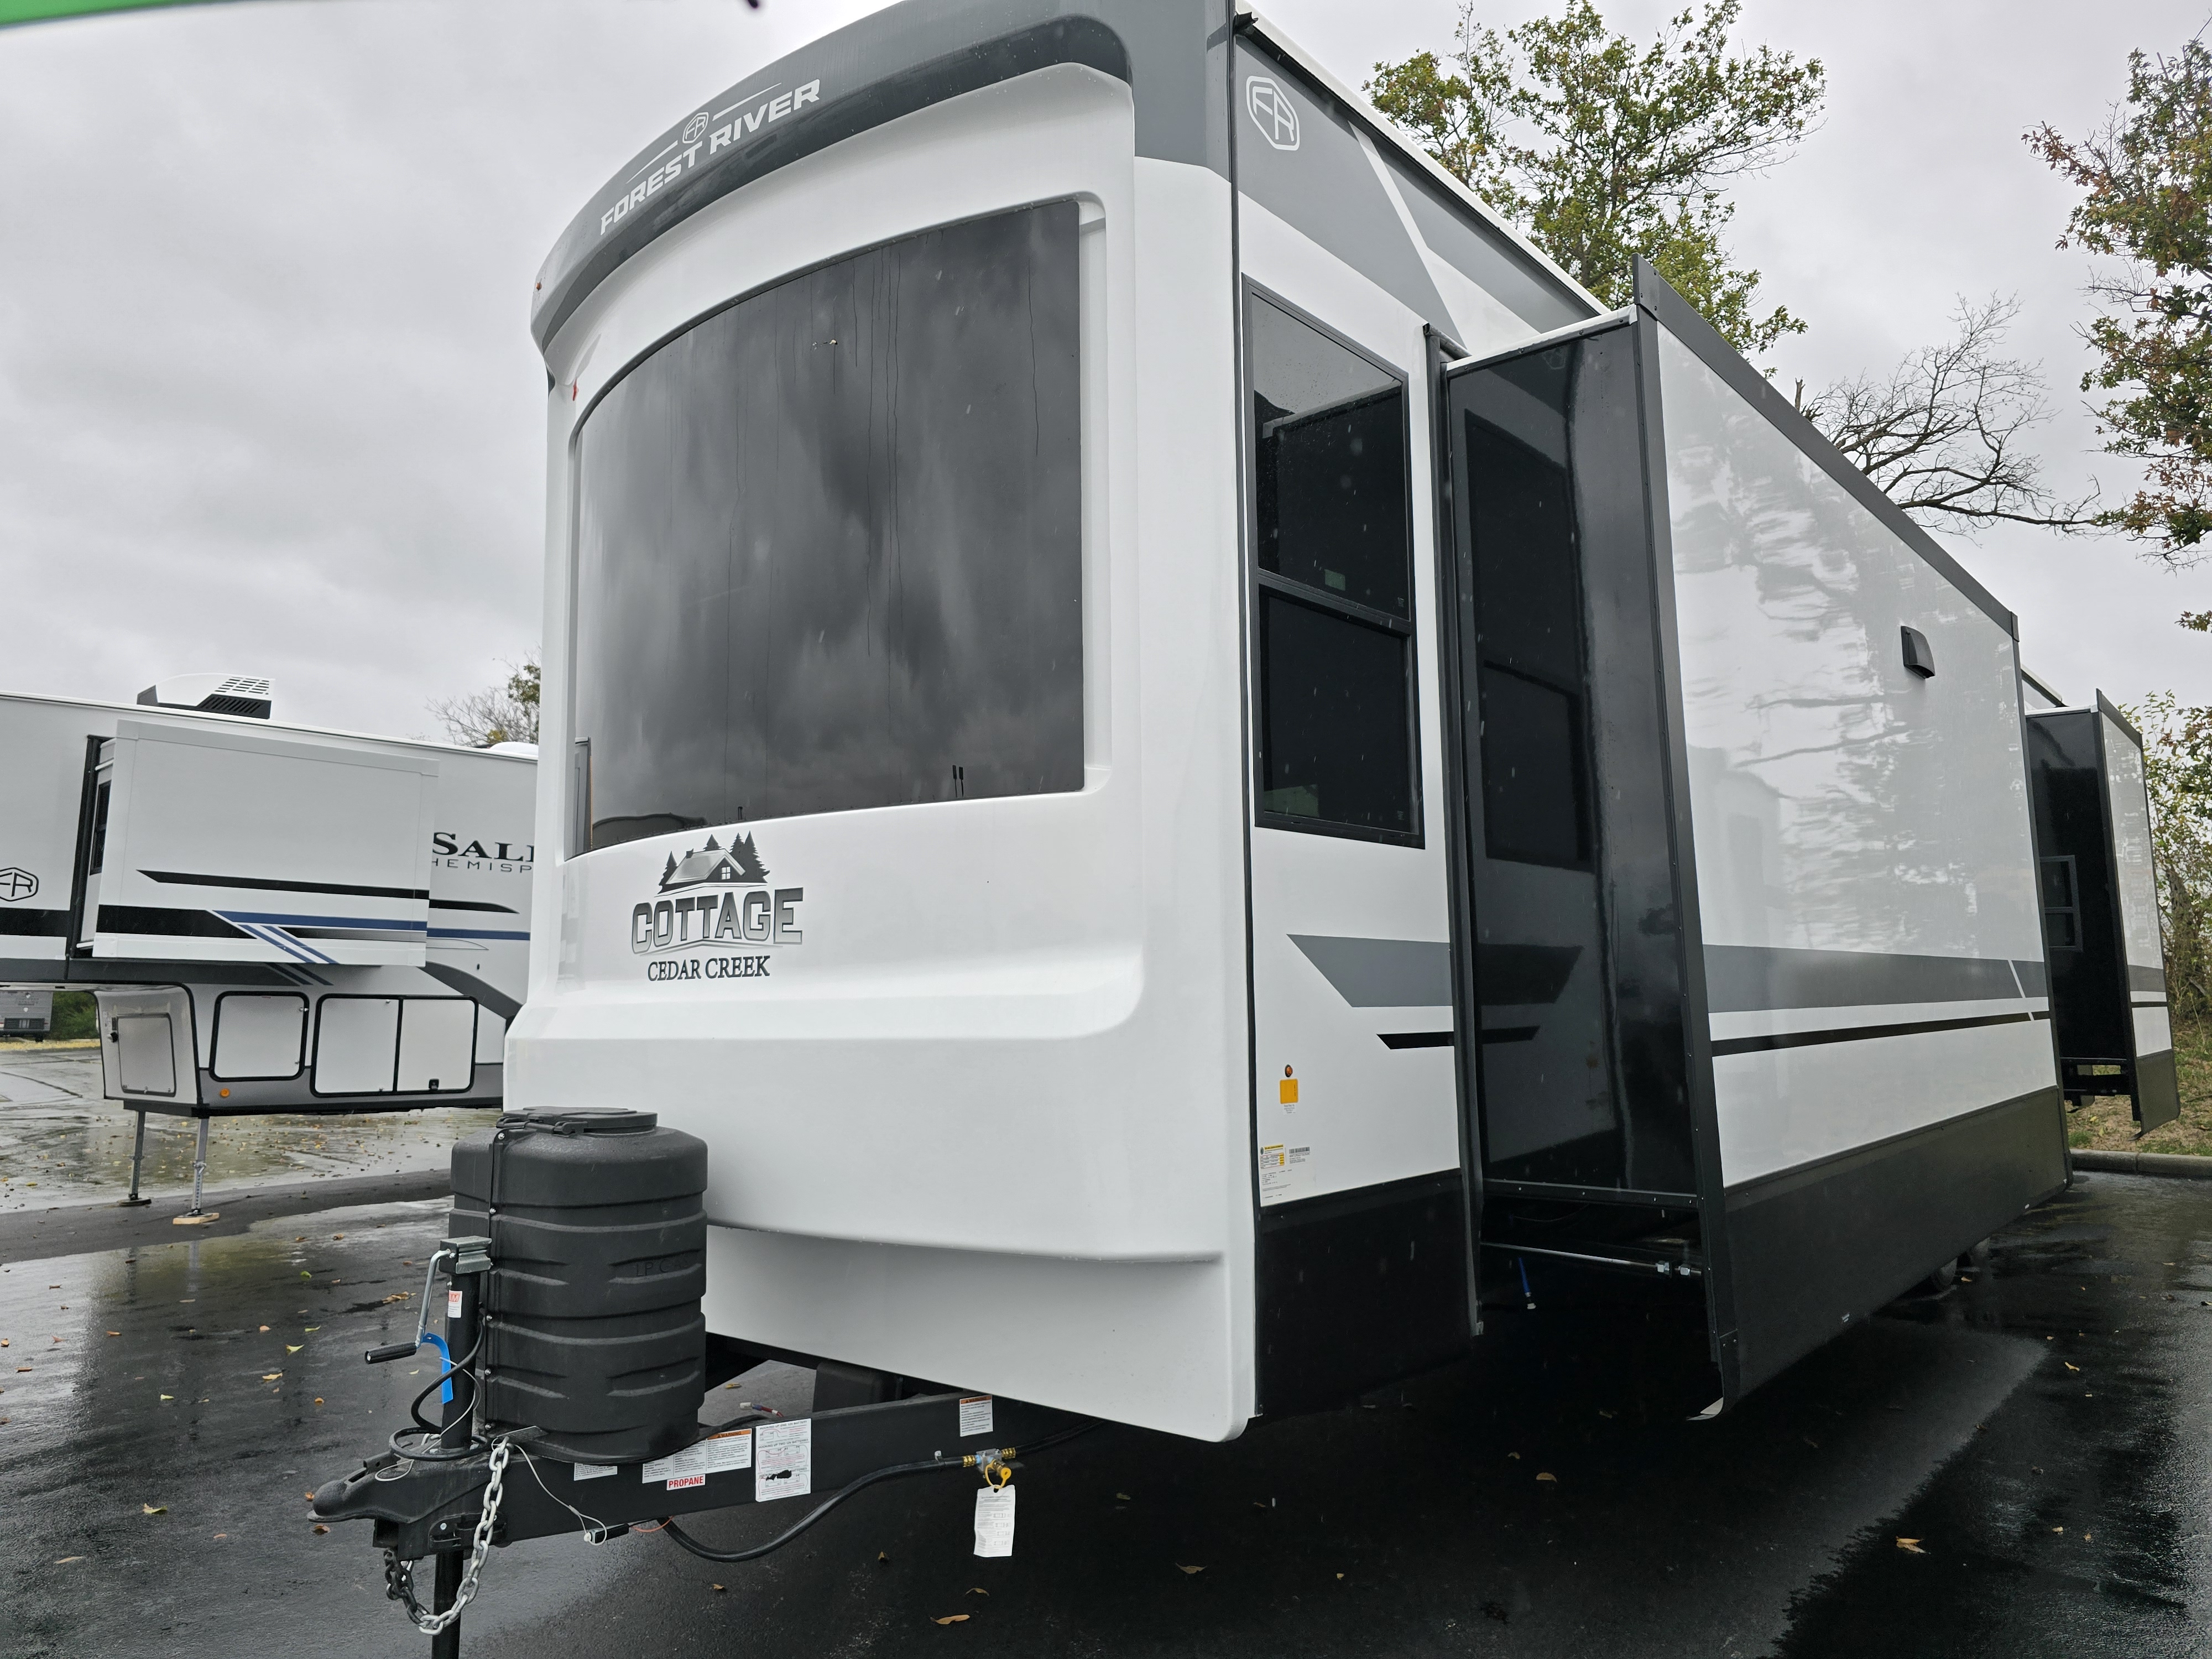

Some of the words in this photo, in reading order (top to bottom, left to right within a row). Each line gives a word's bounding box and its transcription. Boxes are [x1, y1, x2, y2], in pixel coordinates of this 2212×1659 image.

[601, 141, 703, 236] FOREST
[709, 79, 820, 155] RIVER
[632, 887, 804, 955] COTTAGE
[648, 959, 702, 982] CEDAR
[705, 955, 771, 978] CREEK
[669, 1475, 704, 1489] PROPANE
